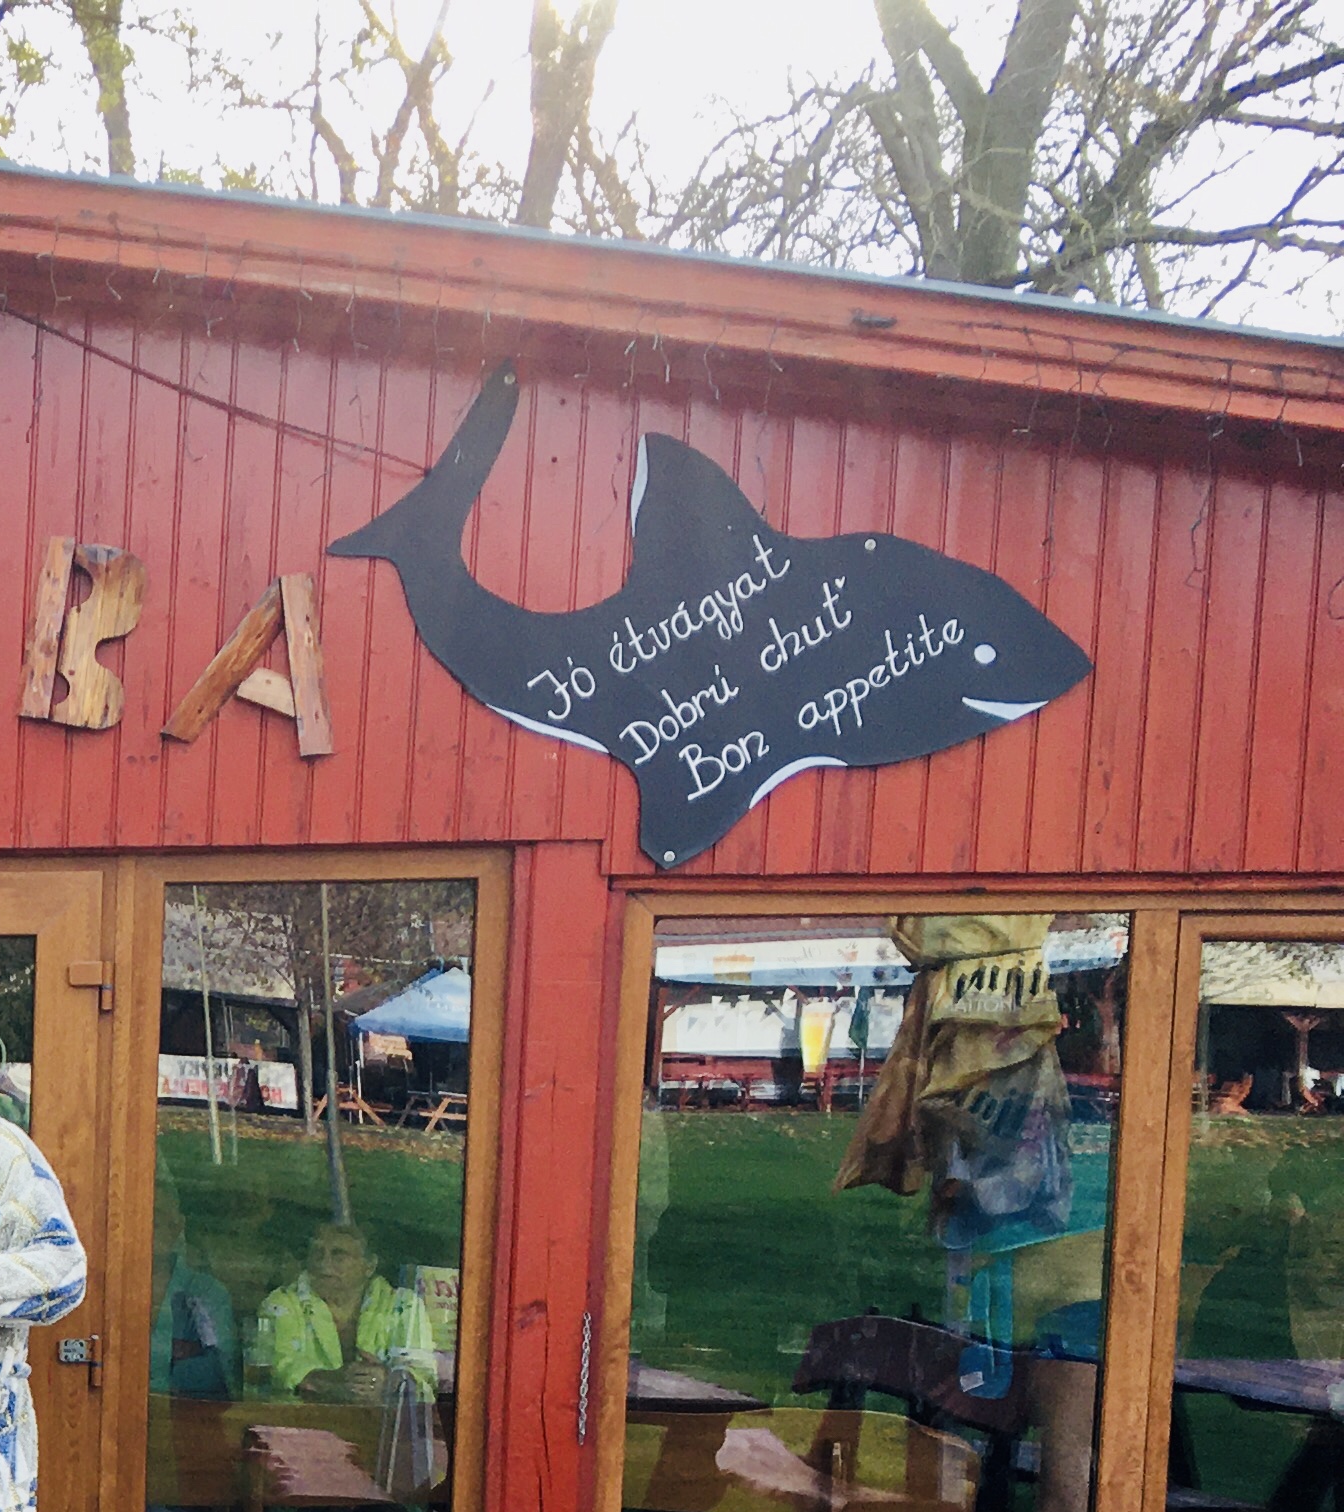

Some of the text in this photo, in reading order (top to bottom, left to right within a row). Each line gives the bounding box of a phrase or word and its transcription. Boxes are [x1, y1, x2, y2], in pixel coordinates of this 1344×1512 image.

[527, 534, 791, 720] Jó étvágyat
[618, 664, 739, 766] Dobrú
[678, 614, 965, 801] Bon appetite
